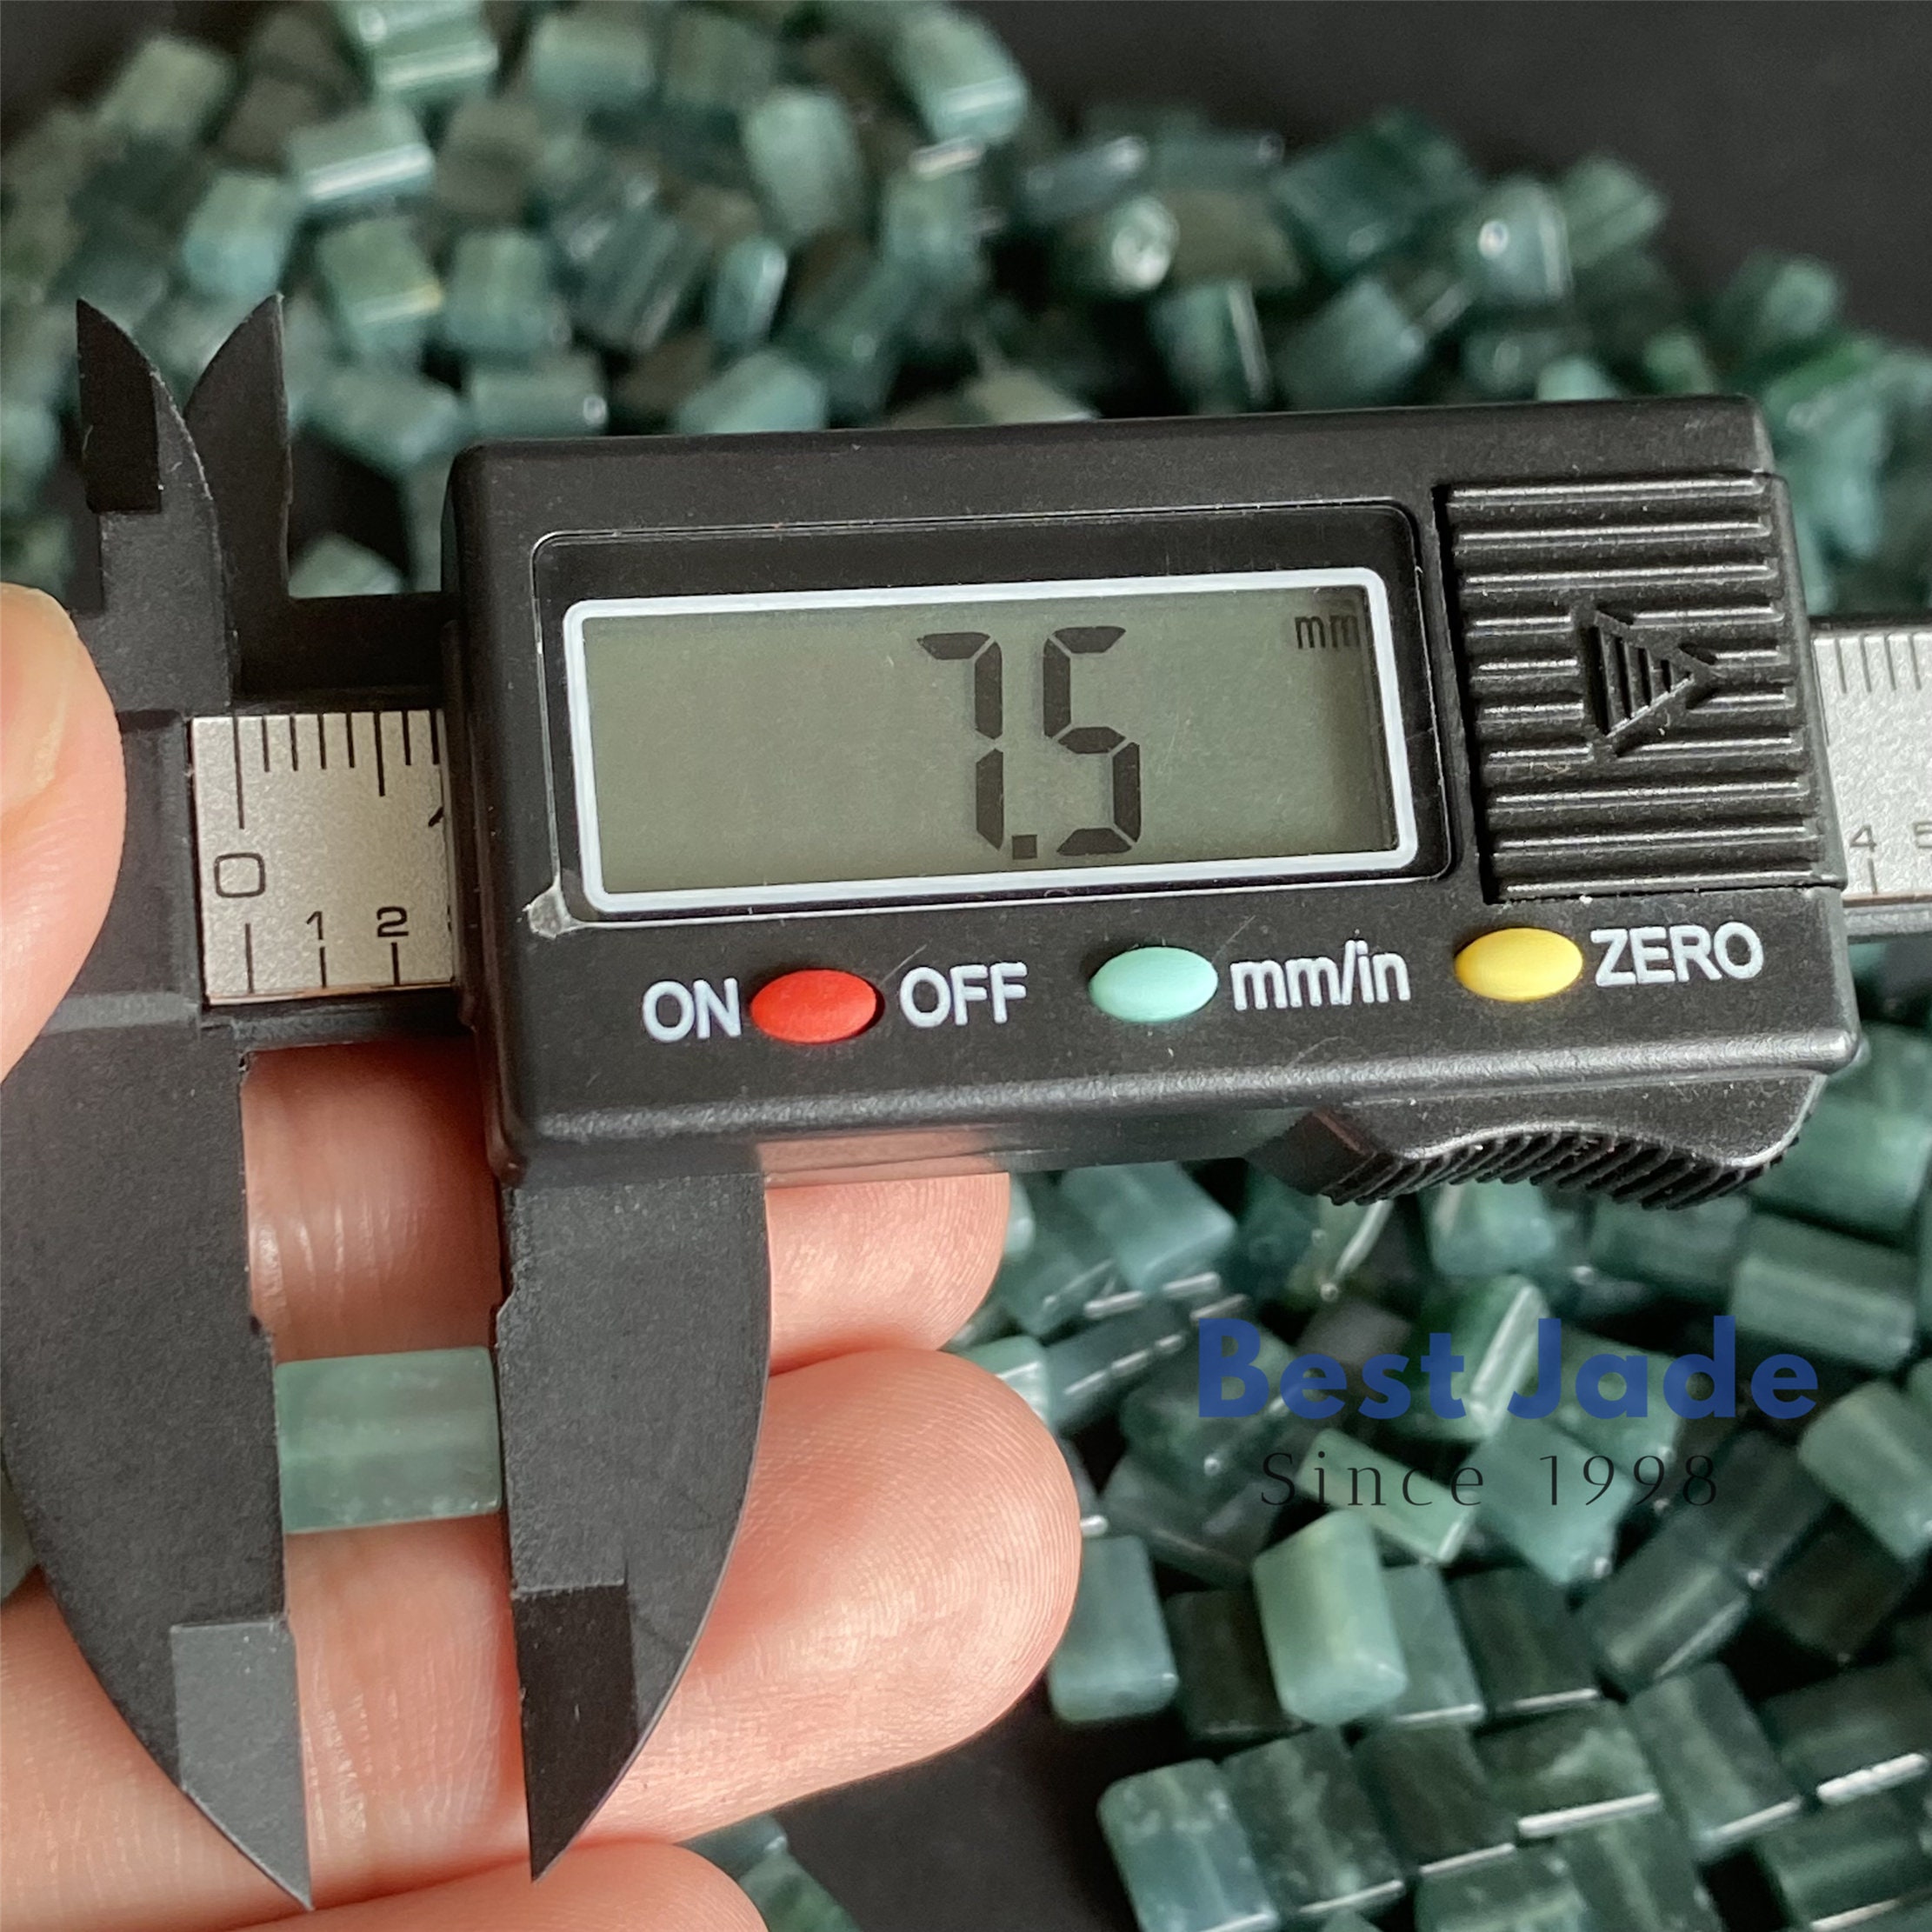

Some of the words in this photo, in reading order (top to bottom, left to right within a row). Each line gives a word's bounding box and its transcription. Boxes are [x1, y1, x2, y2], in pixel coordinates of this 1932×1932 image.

[916, 625, 1142, 860] 7.5
[1295, 612, 1358, 651] mm
[1849, 824, 1877, 853] 4
[306, 910, 323, 940] 1
[376, 906, 410, 938] 2
[1590, 922, 1764, 988] ZERO
[898, 962, 1028, 1028] OFF
[1229, 939, 1411, 1010] mm/in
[642, 977, 742, 1043] ON
